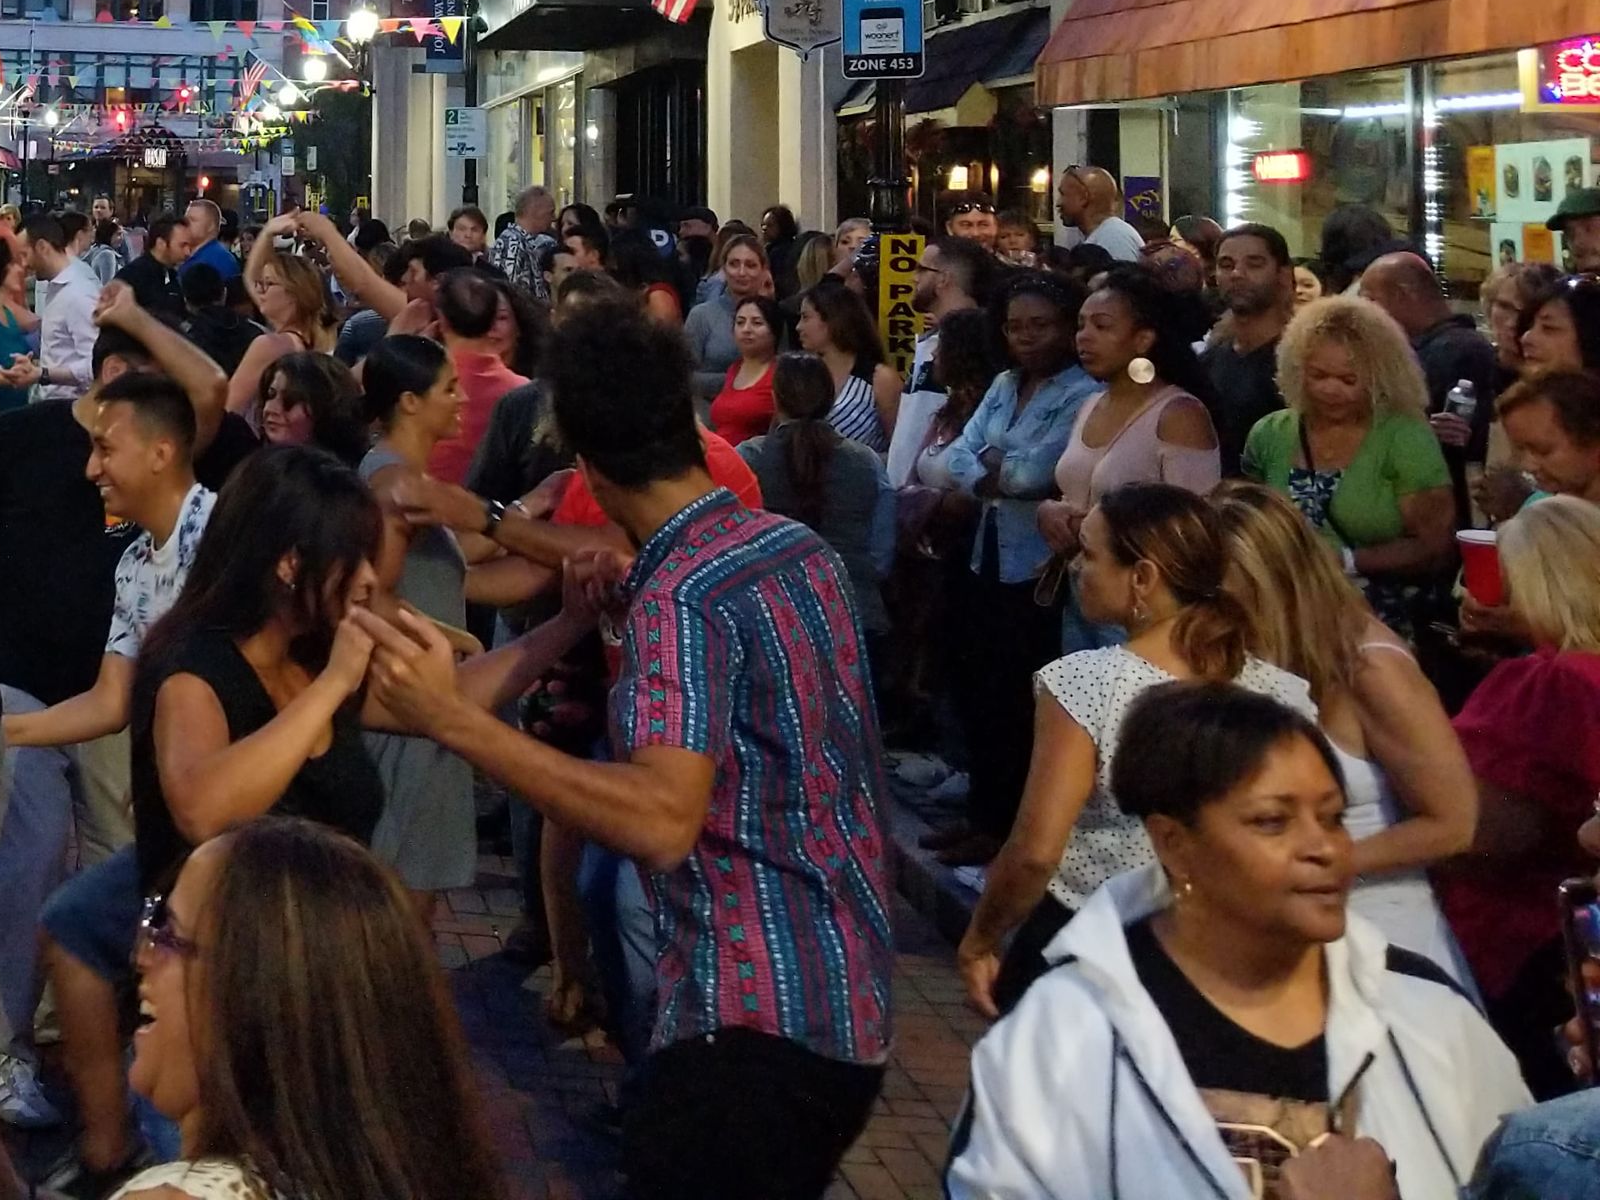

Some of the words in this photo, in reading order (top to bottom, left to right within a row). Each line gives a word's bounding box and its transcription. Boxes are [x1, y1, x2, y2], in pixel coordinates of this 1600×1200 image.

[849, 58, 887, 72] ZONE
[889, 57, 914, 71] 453
[448, 110, 455, 124] 2
[889, 239, 917, 273] NO
[888, 284, 916, 373] PARKI
